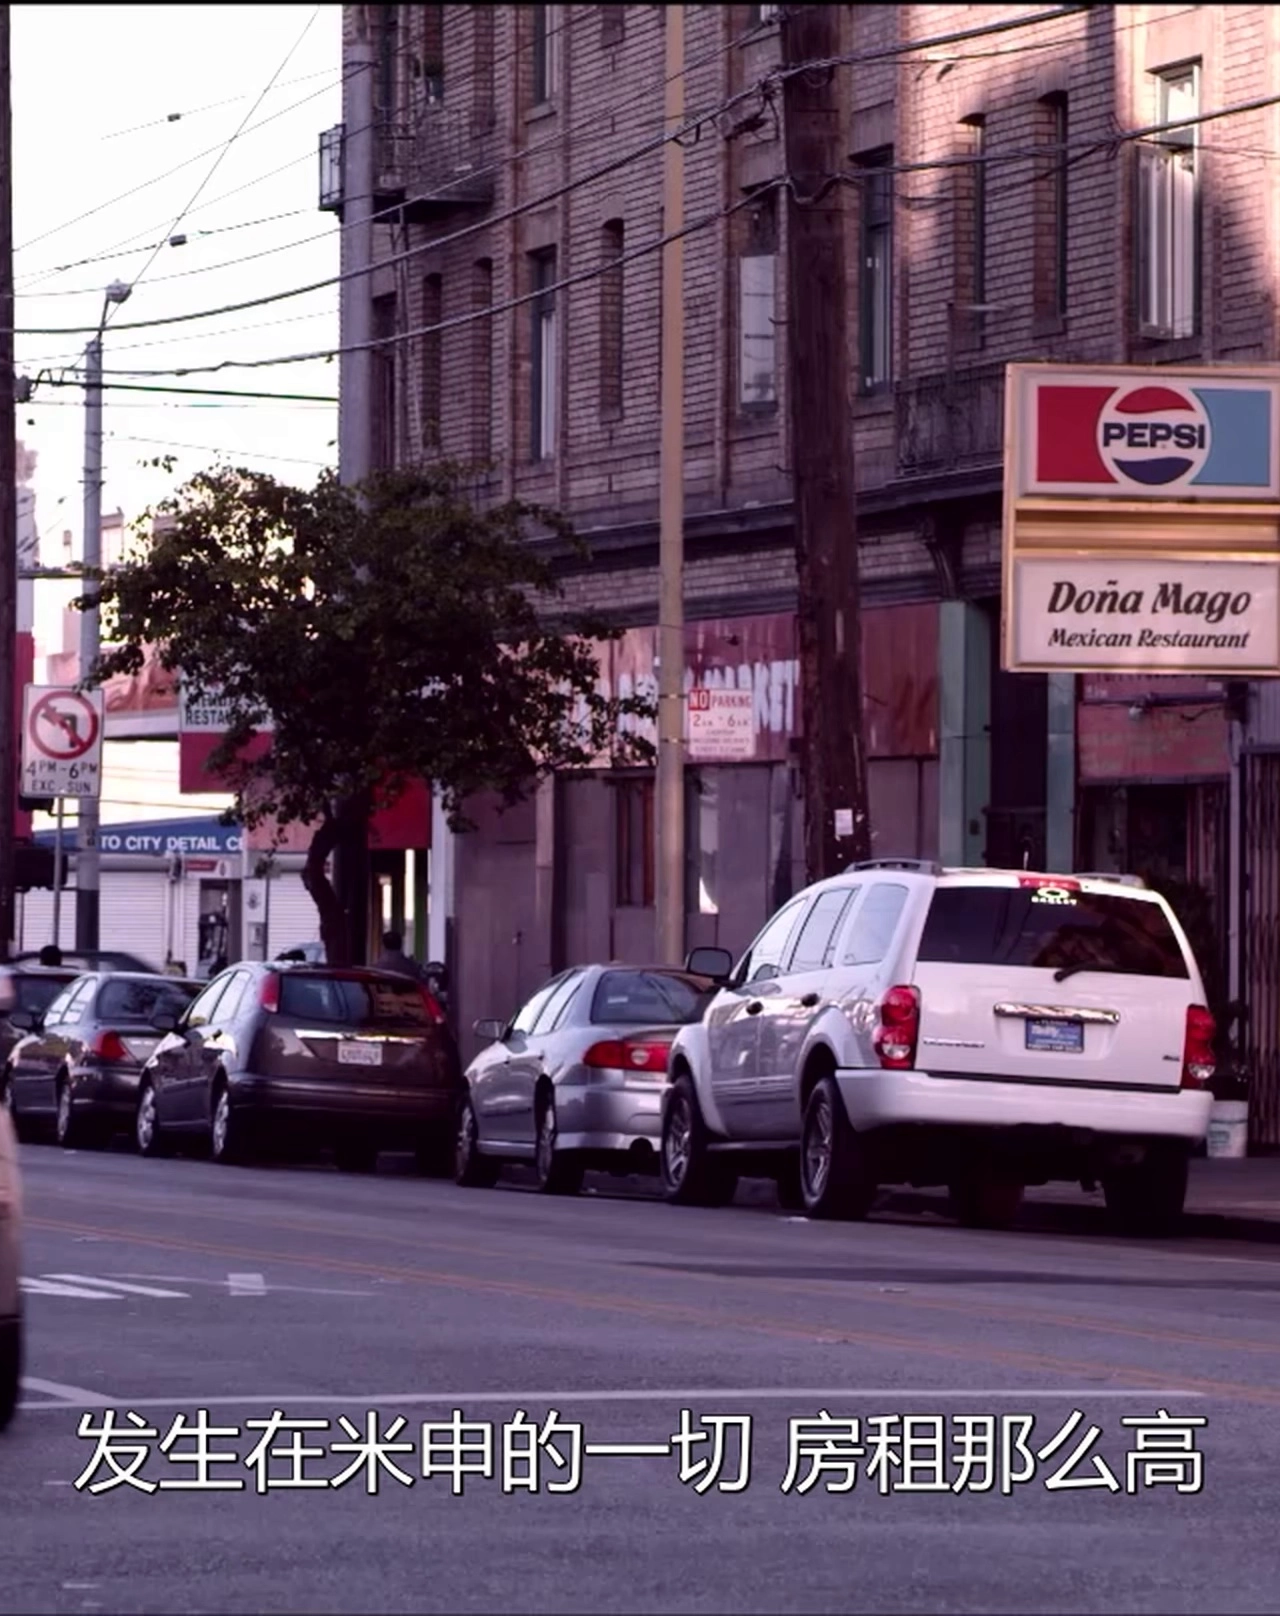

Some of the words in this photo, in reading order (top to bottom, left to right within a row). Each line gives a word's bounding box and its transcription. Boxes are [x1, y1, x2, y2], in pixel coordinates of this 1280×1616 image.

[1103, 422, 1206, 450] PEPSI
[1047, 580, 1144, 614] Doña
[1151, 582, 1252, 624] Mago
[1048, 628, 1132, 648] Mexican
[1137, 628, 1252, 649] Restaurant
[691, 691, 709, 708] NO
[67, 780, 91, 793] SUN
[125, 836, 162, 850] CITY
[167, 836, 221, 851] DETAIL
